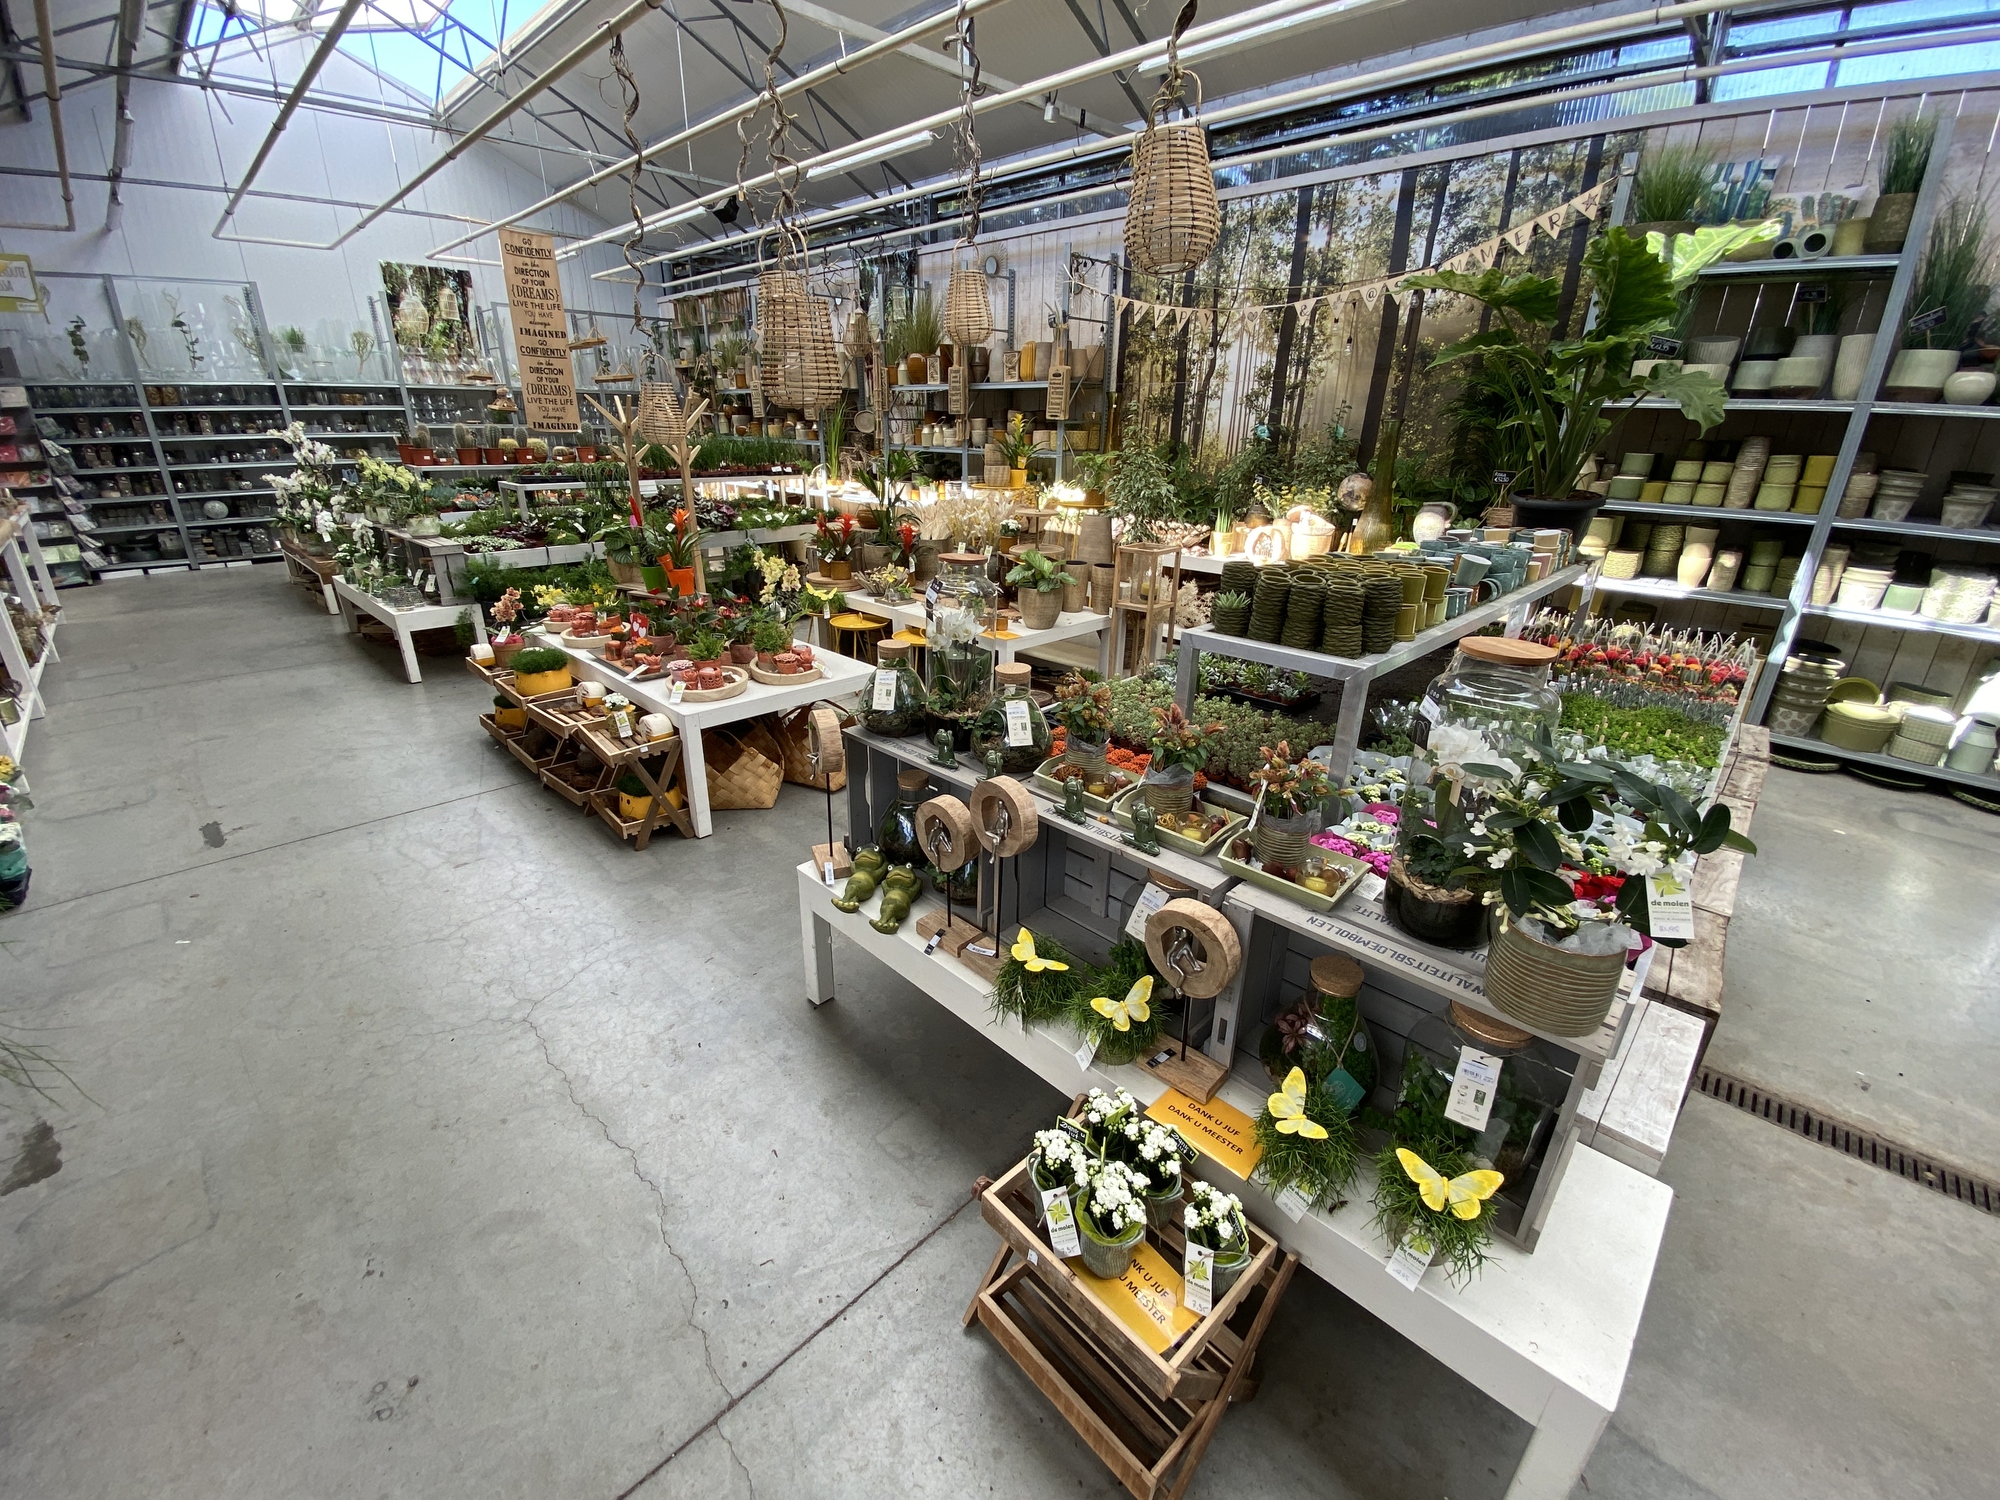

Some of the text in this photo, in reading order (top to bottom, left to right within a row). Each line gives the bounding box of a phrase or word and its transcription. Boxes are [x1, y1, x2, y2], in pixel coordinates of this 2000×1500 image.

[522, 238, 532, 246] GO
[504, 243, 552, 257] CONFIDENTLY
[530, 260, 540, 268] the
[514, 266, 550, 278] DIRECTION
[530, 279, 546, 287] YOUR
[512, 299, 561, 311] LIVE THE LIFE
[524, 310, 554, 319] YOU HAVE
[1117, 299, 1211, 327] HAPPY
[519, 327, 567, 339] IMAGINED
[520, 345, 567, 357] CONFIDENTLY
[545, 359, 554, 367] the
[529, 366, 564, 376] DIRECTION
[526, 396, 574, 406] LIVE THE LIFE
[538, 405, 550, 413] YOU
[532, 421, 579, 431] IMAGINED
[1306, 916, 1487, 997] WALITEITSBLOEMBOLLEN
[1188, 1102, 1241, 1136] DANK U JUF
[1167, 1104, 1244, 1155] DANK U MEESTER
[1058, 1224, 1074, 1232] molen
[1407, 1252, 1426, 1268] molen
[1131, 1258, 1170, 1298] NK U JUF
[1194, 1282, 1211, 1293] molen
[1125, 1281, 1166, 1324] MEESTER
